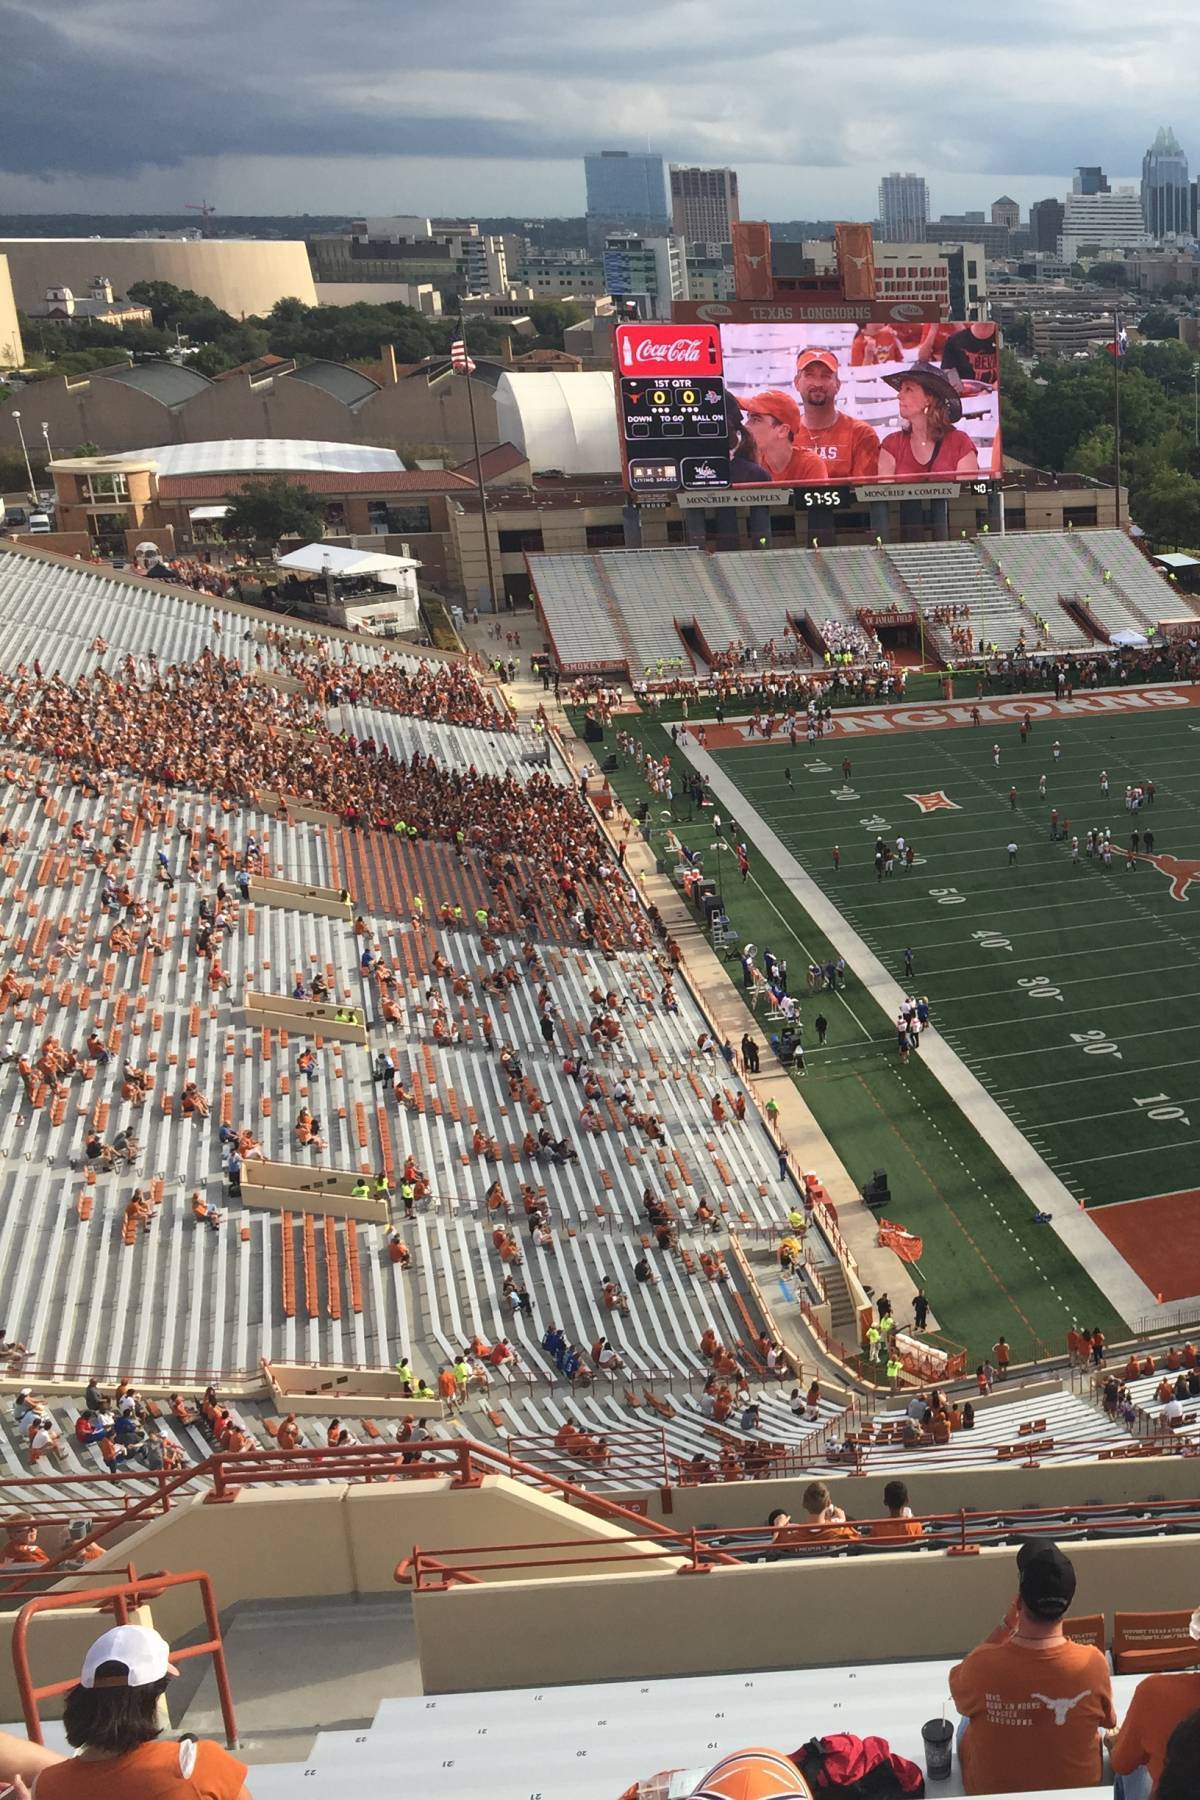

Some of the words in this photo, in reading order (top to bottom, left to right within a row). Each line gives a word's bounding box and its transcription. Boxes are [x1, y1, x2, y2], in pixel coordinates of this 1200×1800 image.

[751, 307, 793, 320] TEXAS
[800, 307, 871, 320] LONGHORNS
[636, 339, 703, 362] Coca-Cola
[654, 380, 670, 388] 1ST
[672, 380, 692, 388] QTR
[653, 391, 666, 404] 0
[683, 390, 695, 404] 0
[627, 415, 653, 423] DOWN
[914, 487, 953, 496] COMPLEX
[973, 483, 987, 493] 40
[686, 495, 732, 504] MONCRIEF
[740, 494, 781, 503] COMPLEX
[804, 491, 841, 506] 57:55
[733, 690, 1190, 741] LONGHORNS
[928, 888, 967, 905] 50
[971, 930, 1012, 950] 40
[1017, 976, 1061, 998] 30
[1069, 1029, 1119, 1055] 20
[1131, 1092, 1185, 1121] 10
